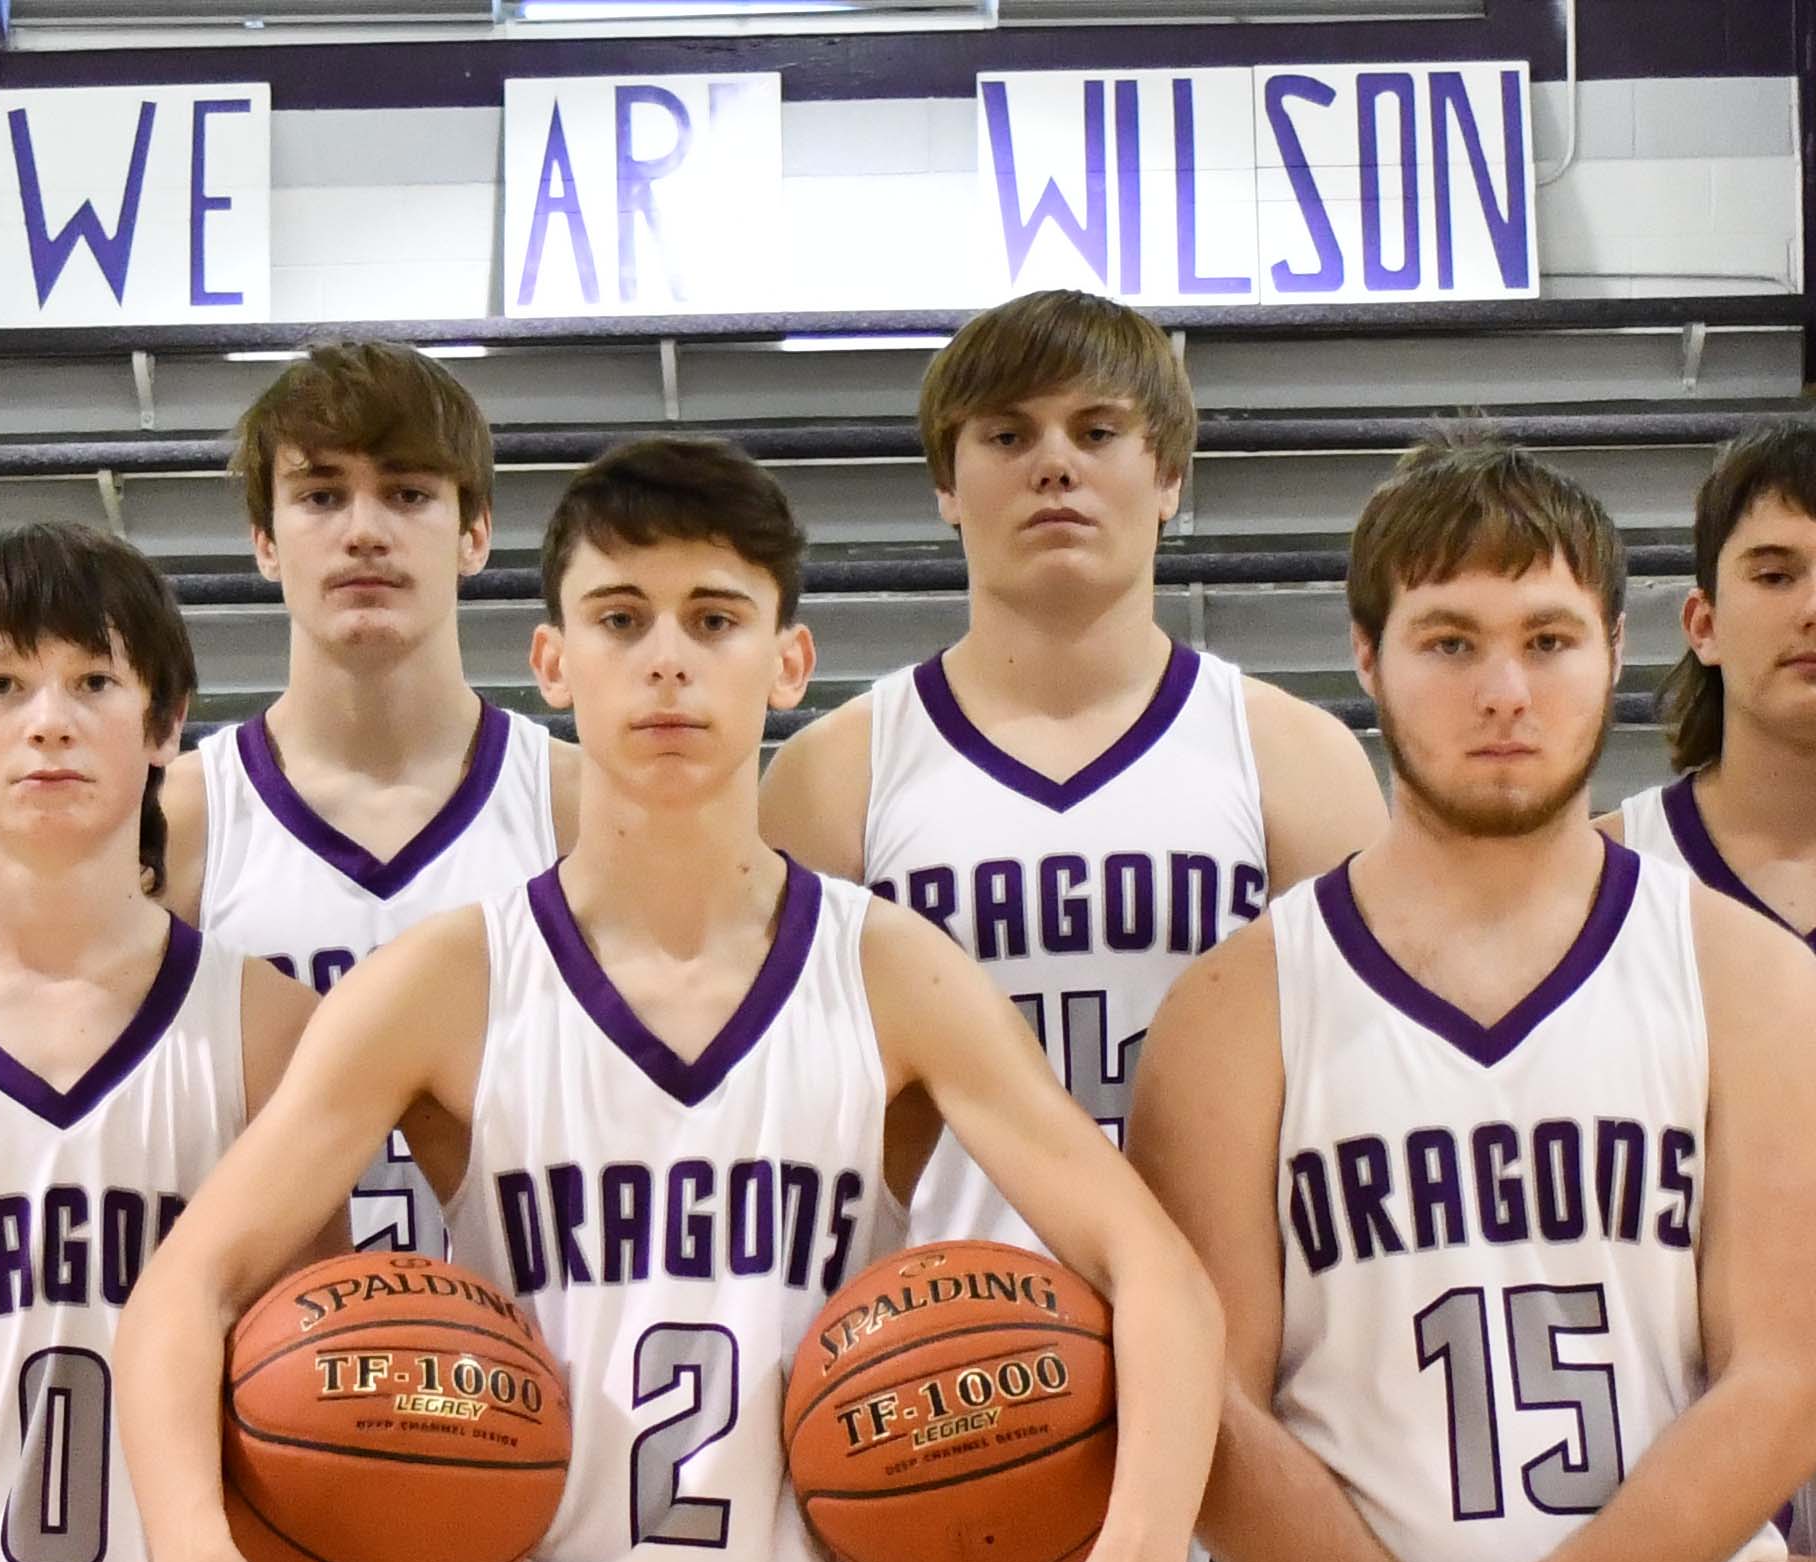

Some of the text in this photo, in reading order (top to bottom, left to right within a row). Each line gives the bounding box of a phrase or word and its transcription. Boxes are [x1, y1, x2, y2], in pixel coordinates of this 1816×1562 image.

[8, 70, 1529, 307] WE AR WILSON
[494, 1156, 864, 1298] DRAGONS
[1287, 1115, 1698, 1278] DRAGONS
[315, 1352, 544, 1413] TF-1000
[819, 1271, 1060, 1377] SPALDING
[395, 1395, 489, 1421] LEGACY
[630, 1321, 740, 1550] 2
[837, 1352, 1070, 1449] TF-1000
[912, 1407, 1002, 1450] LEGACY
[1413, 1282, 1624, 1523] 15
